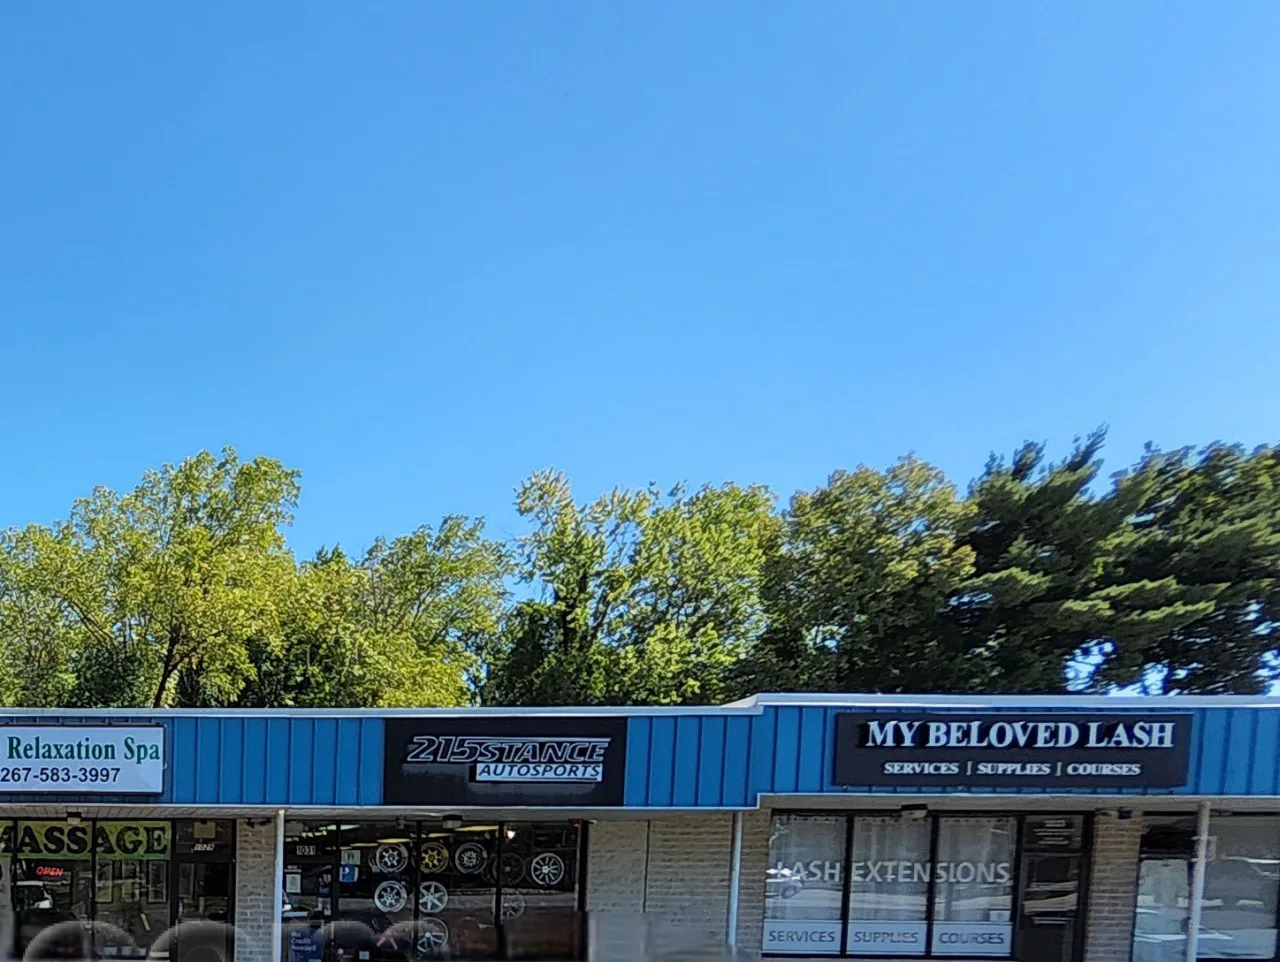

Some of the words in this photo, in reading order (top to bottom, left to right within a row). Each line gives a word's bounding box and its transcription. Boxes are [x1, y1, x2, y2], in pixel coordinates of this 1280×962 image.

[865, 721, 920, 747] MY
[925, 721, 1080, 748] BELOVED
[1084, 721, 1177, 748] LASH
[7, 736, 116, 760] Relaxation
[123, 736, 160, 764] Spa
[0, 767, 121, 783] 267-583-3997
[478, 764, 601, 777] AUTOSPORTS
[883, 762, 960, 775] SERVICES
[976, 762, 1051, 776] SUPPLIES
[1066, 763, 1142, 776] COURSES
[297, 845, 316, 855] 1031
[35, 866, 65, 877] OPEN
[851, 862, 1011, 883] EXTENSIONS
[768, 930, 836, 943] SERVICES
[853, 931, 919, 943] SUPPLIES
[938, 932, 1005, 945] COURSES
